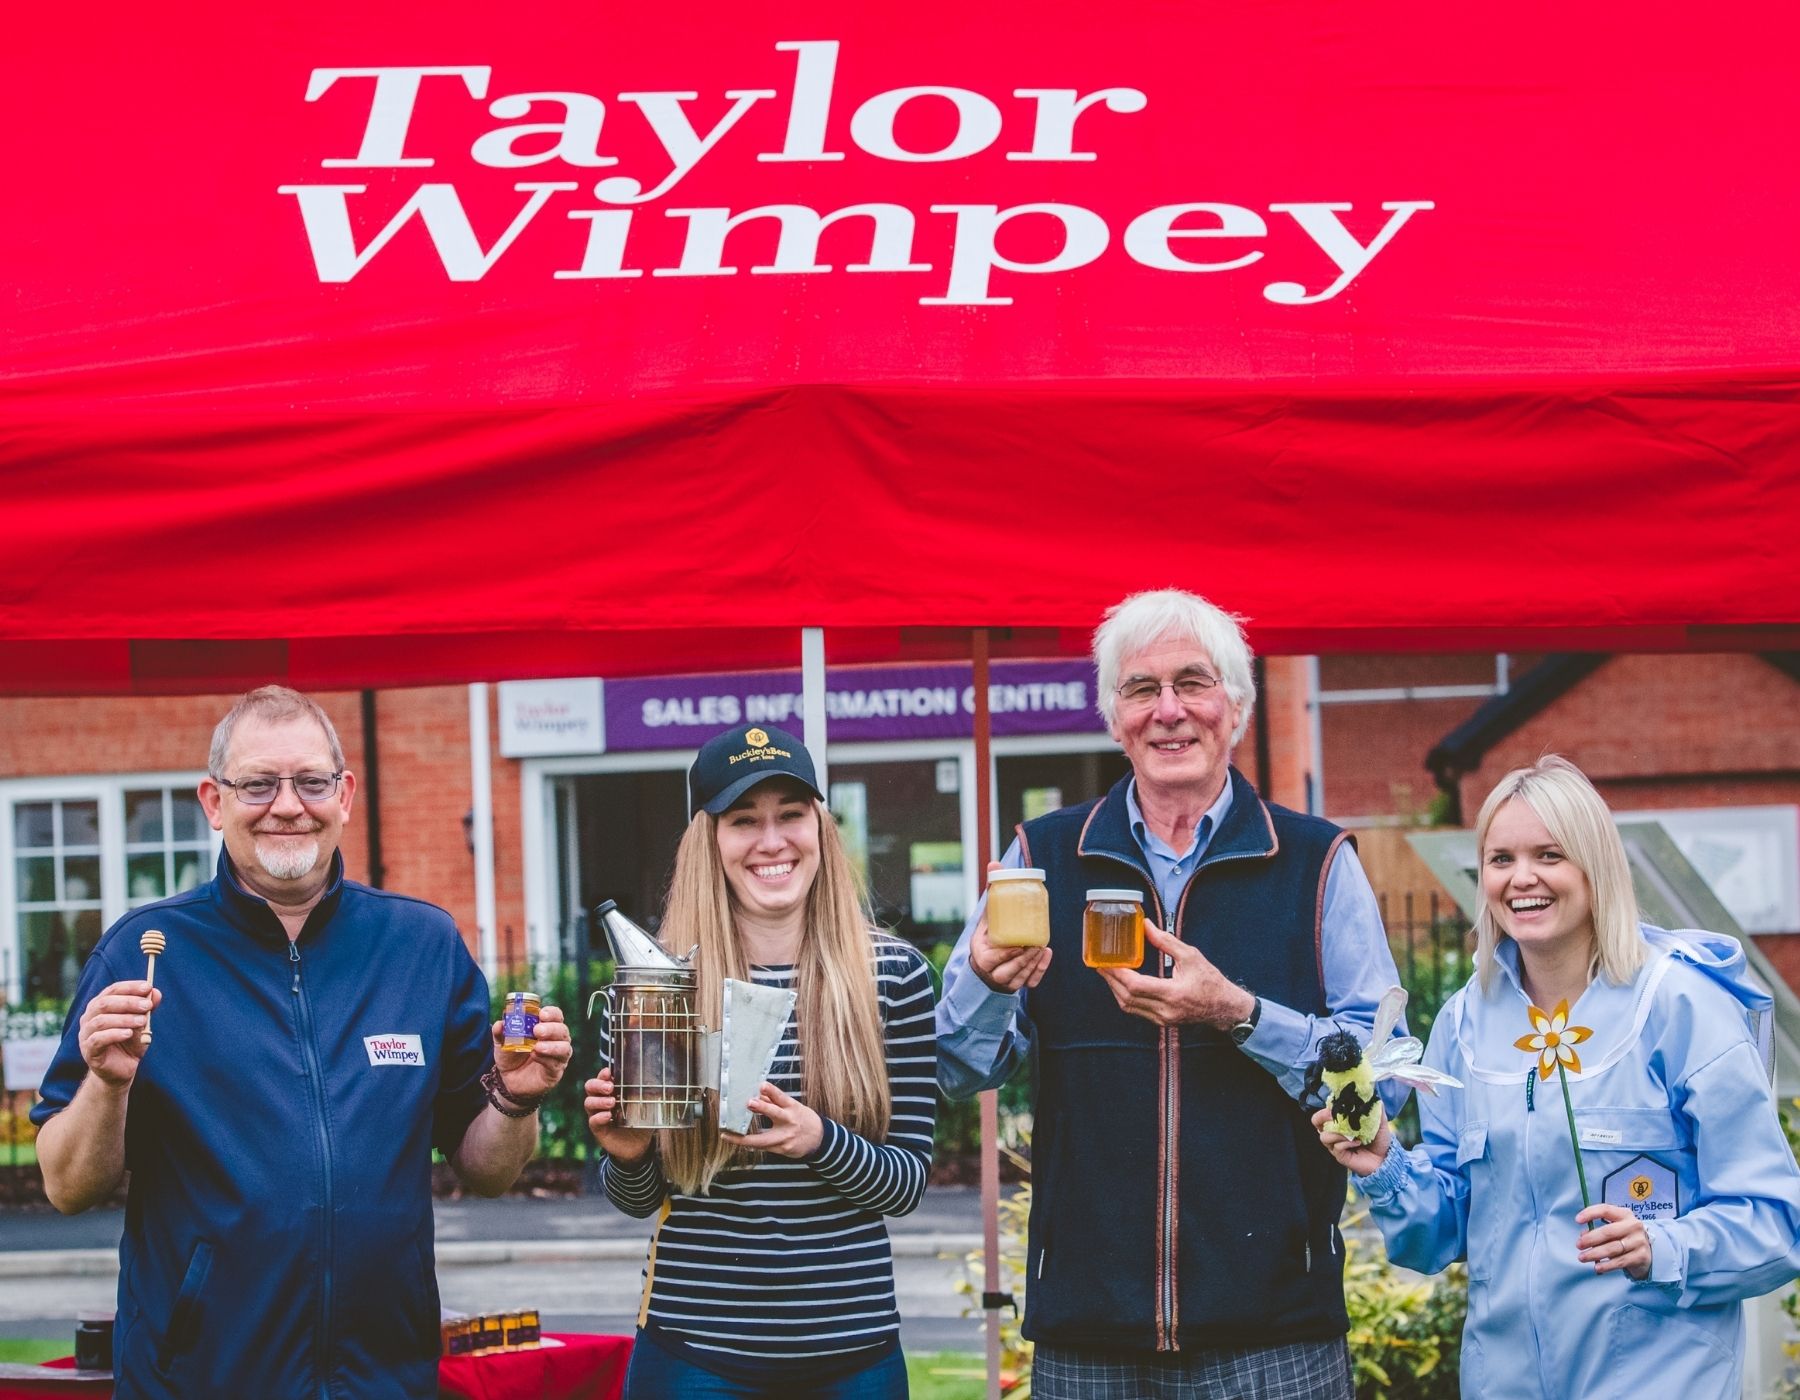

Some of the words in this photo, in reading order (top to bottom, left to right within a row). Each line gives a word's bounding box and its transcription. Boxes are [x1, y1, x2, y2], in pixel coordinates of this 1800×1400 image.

[304, 40, 1148, 205] Taylor
[277, 181, 1435, 306] Wimpey
[641, 695, 741, 727] SALES
[370, 1038, 407, 1051] Taylor
[374, 1049, 419, 1063] Wimpey
